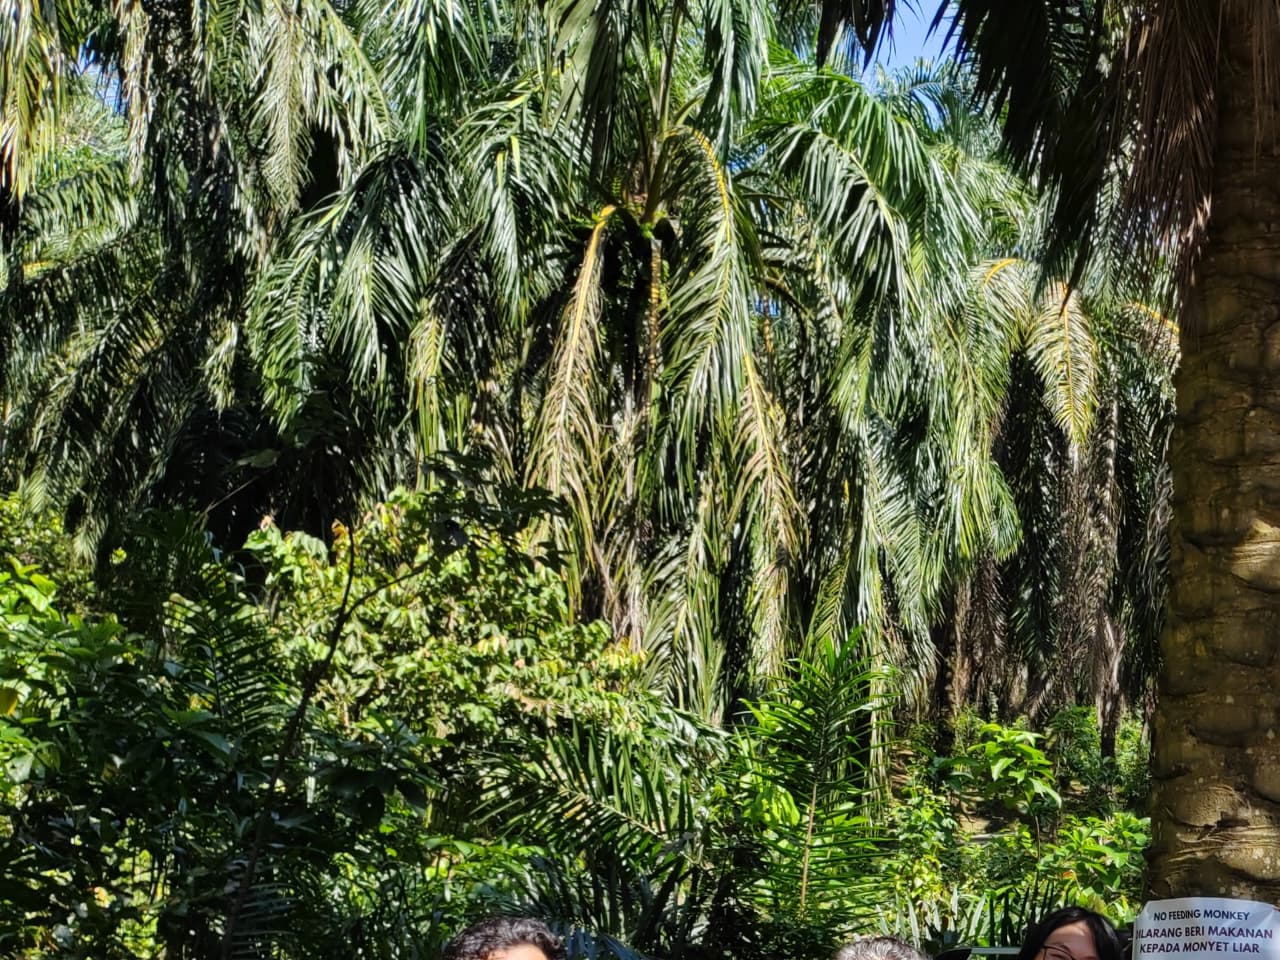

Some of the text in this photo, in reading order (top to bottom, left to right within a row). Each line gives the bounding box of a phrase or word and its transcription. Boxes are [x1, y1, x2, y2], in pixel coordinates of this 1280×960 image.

[1154, 909, 1250, 920] NO FEEDING MONKEY
[1185, 927, 1204, 936] BERI
[1208, 926, 1273, 939] MAKANAN
[1140, 942, 1260, 953] KEPADA MONYET LIAR
